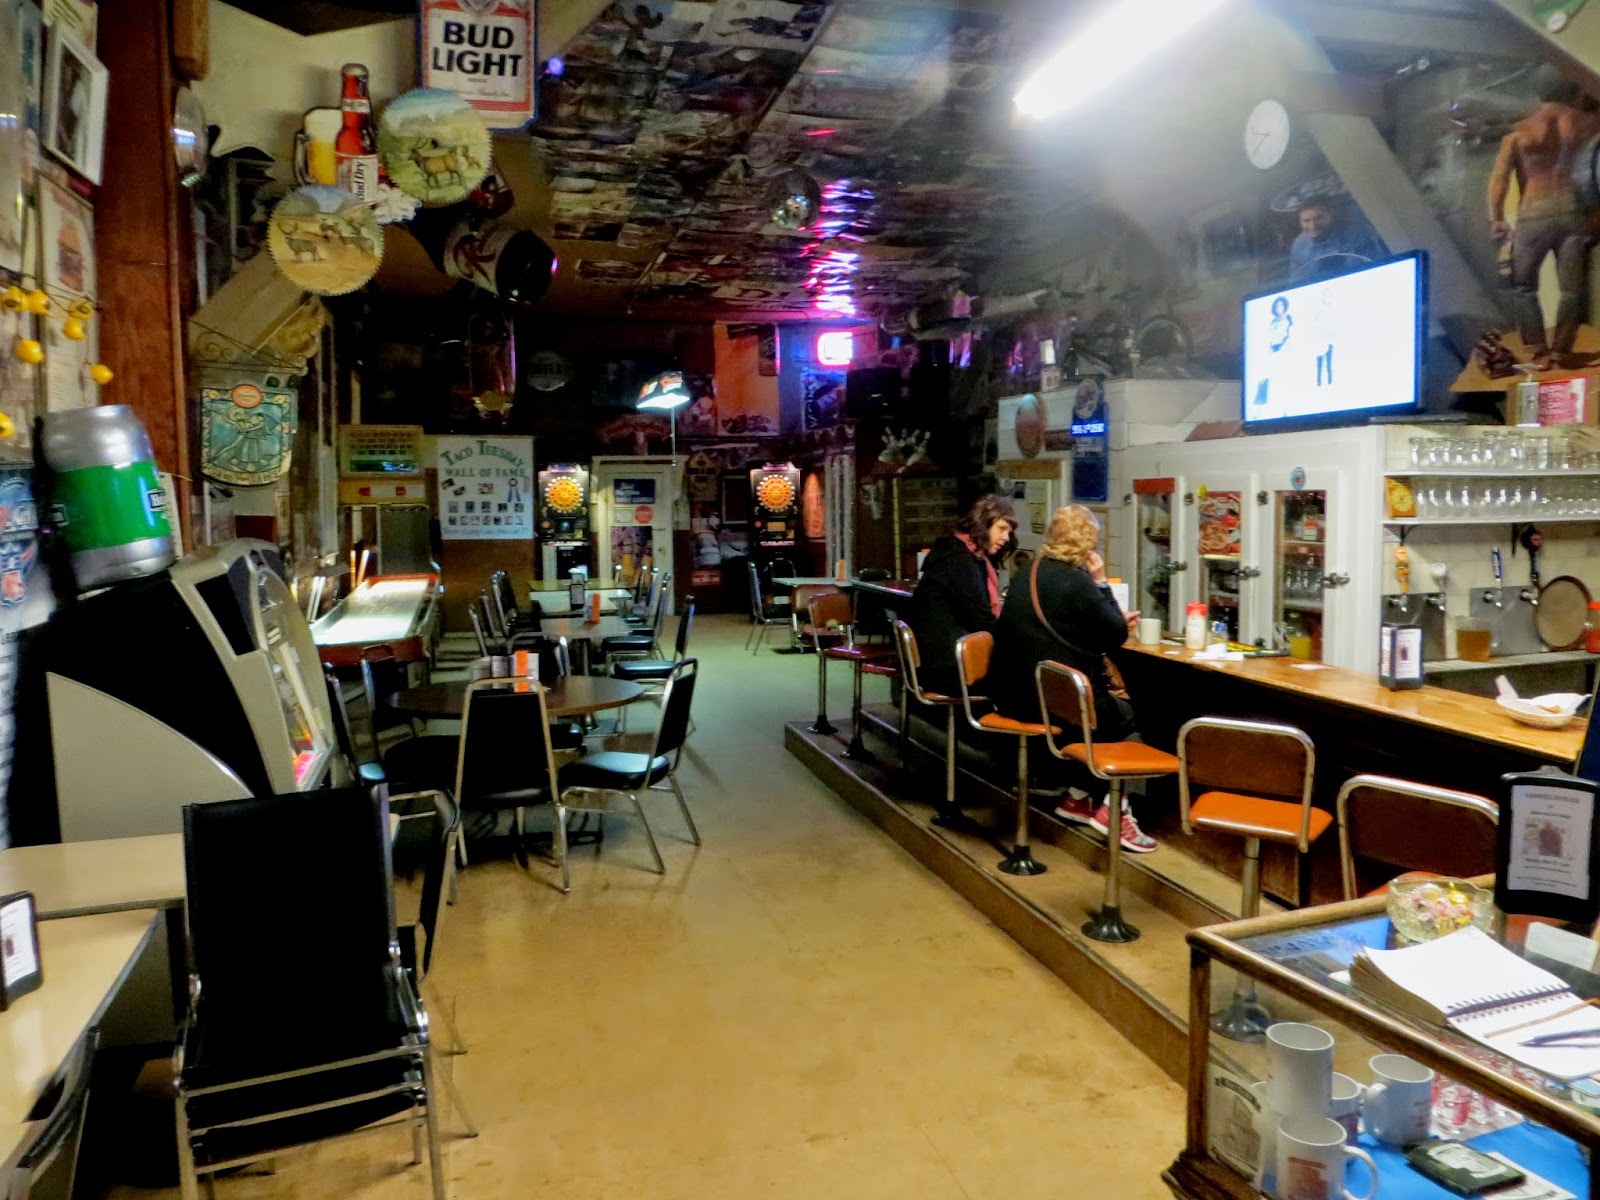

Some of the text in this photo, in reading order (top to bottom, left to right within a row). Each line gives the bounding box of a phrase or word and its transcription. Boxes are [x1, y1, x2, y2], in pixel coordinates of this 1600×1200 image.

[443, 21, 514, 49] BUD
[433, 47, 523, 77] LIGHT
[354, 160, 369, 179] Dry
[445, 468, 525, 477] WALL OF FAME
